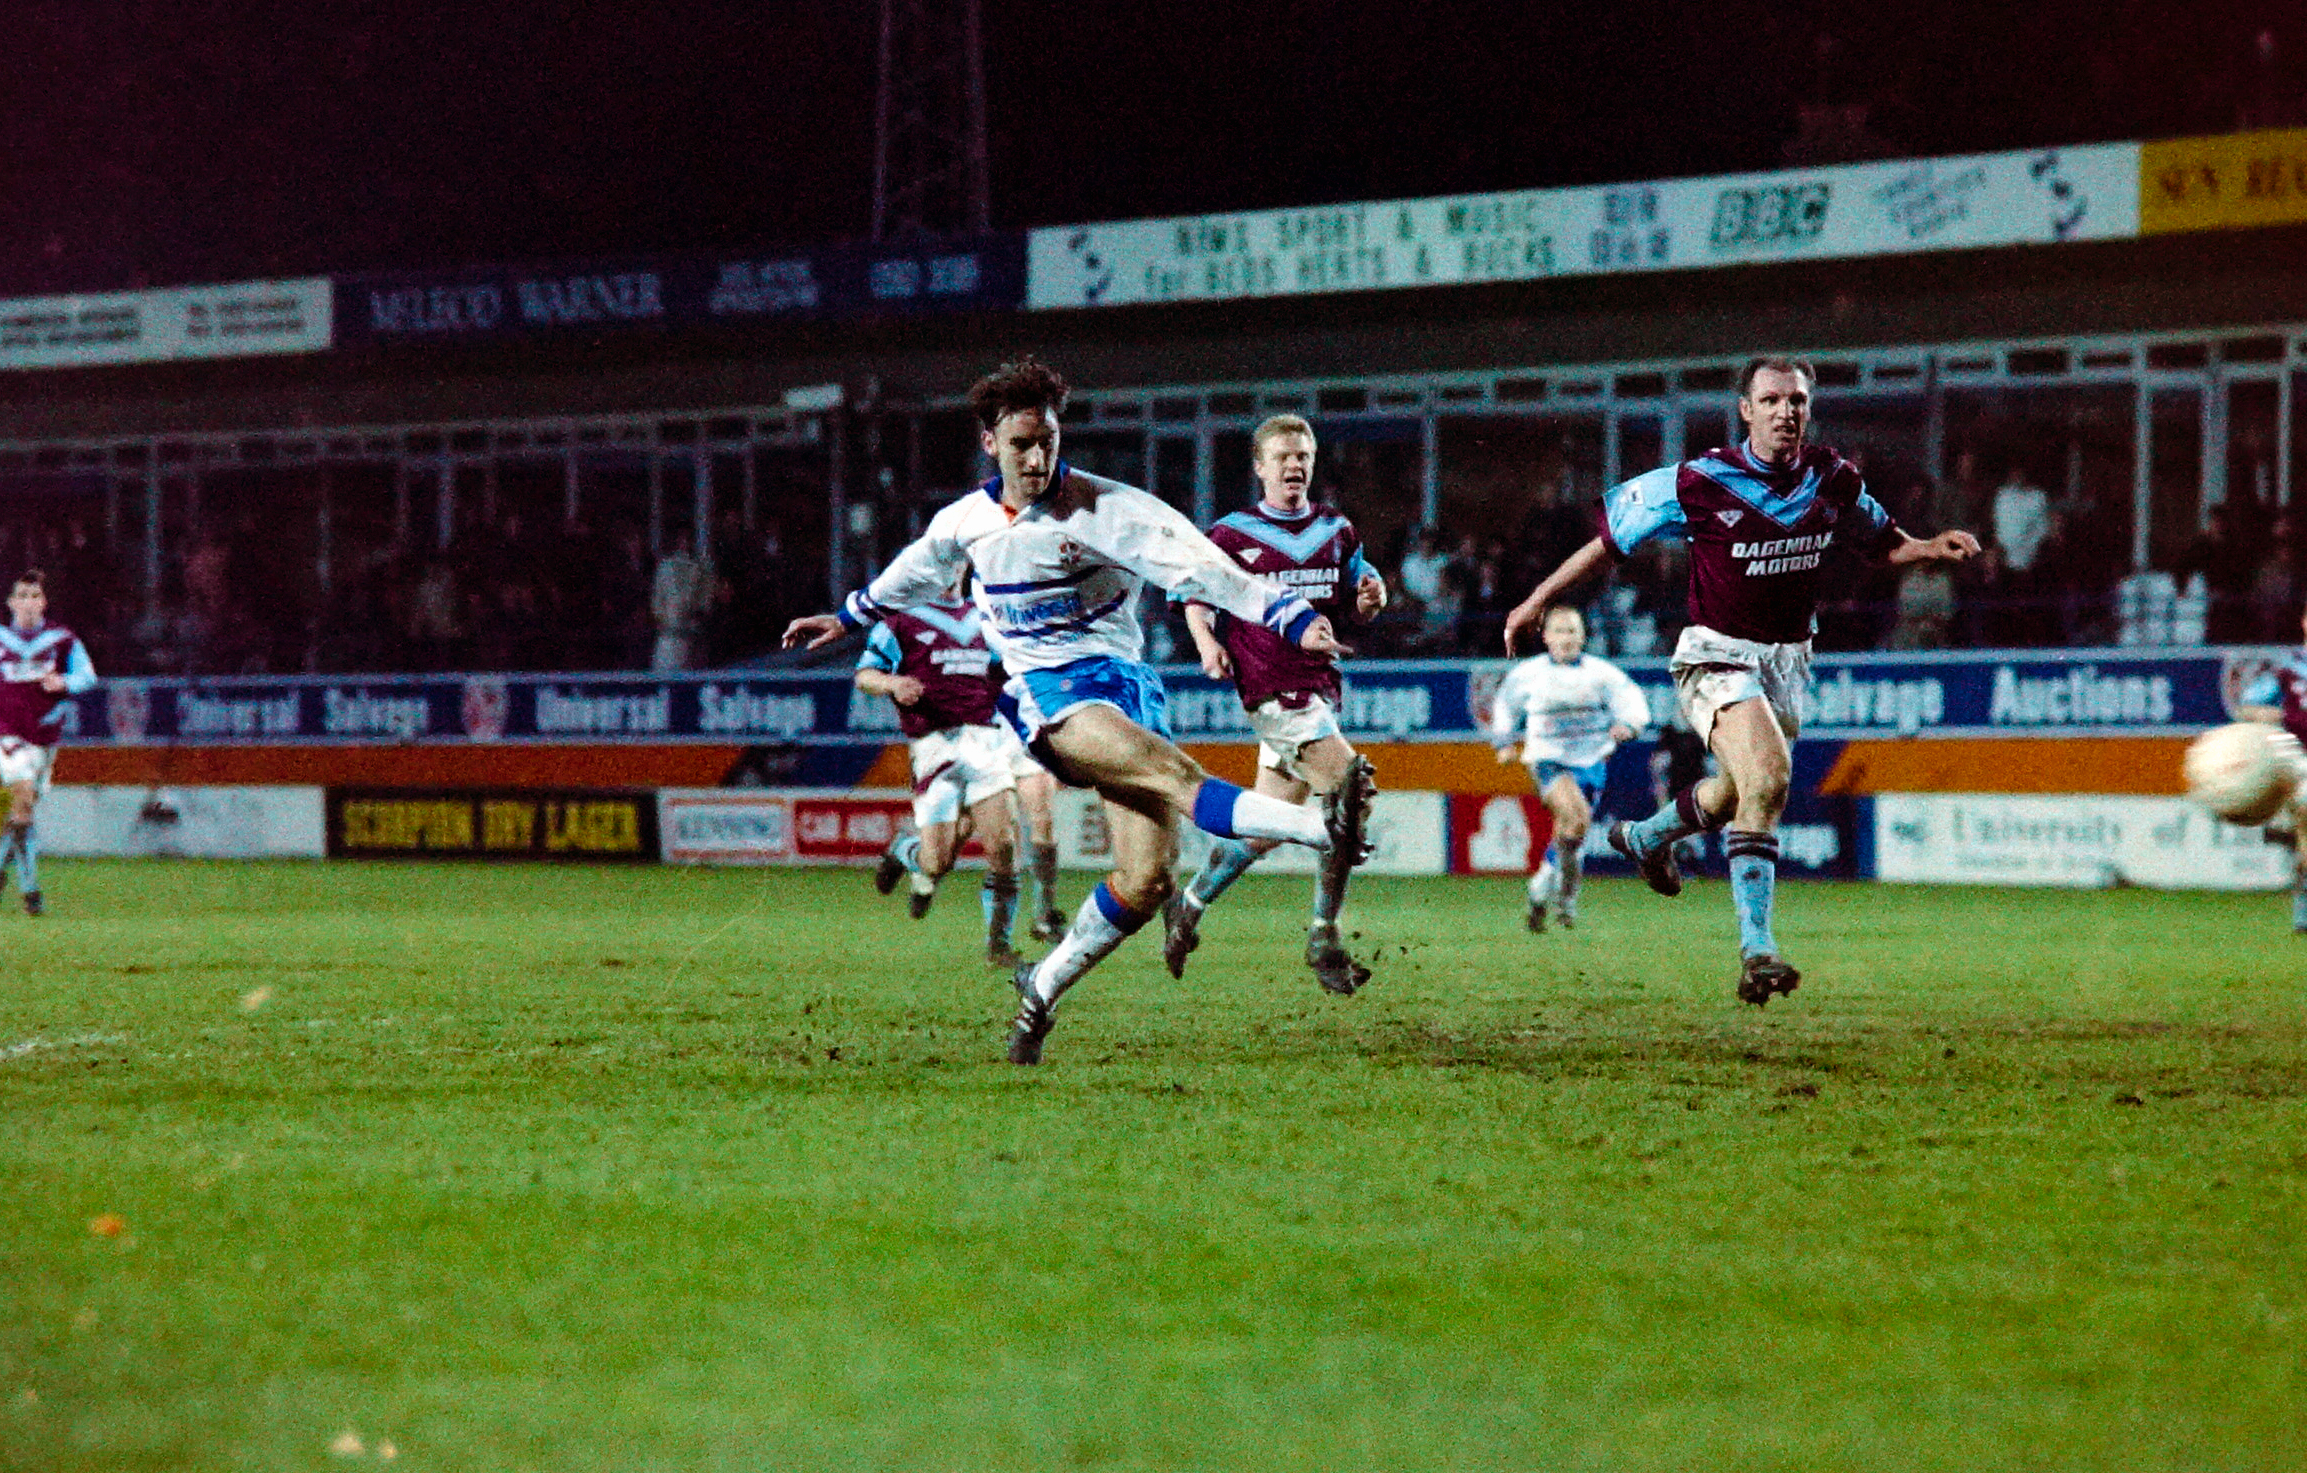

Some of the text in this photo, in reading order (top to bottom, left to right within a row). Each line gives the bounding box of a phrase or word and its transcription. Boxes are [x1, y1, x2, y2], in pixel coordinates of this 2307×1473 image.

[1276, 208, 1366, 250] SPORT
[1446, 196, 1537, 234] MUSIC
[1710, 179, 1830, 246] BBC
[1745, 552, 1821, 576] MOTORS
[699, 682, 815, 738] Salvage
[1991, 664, 2175, 723] Auctions
